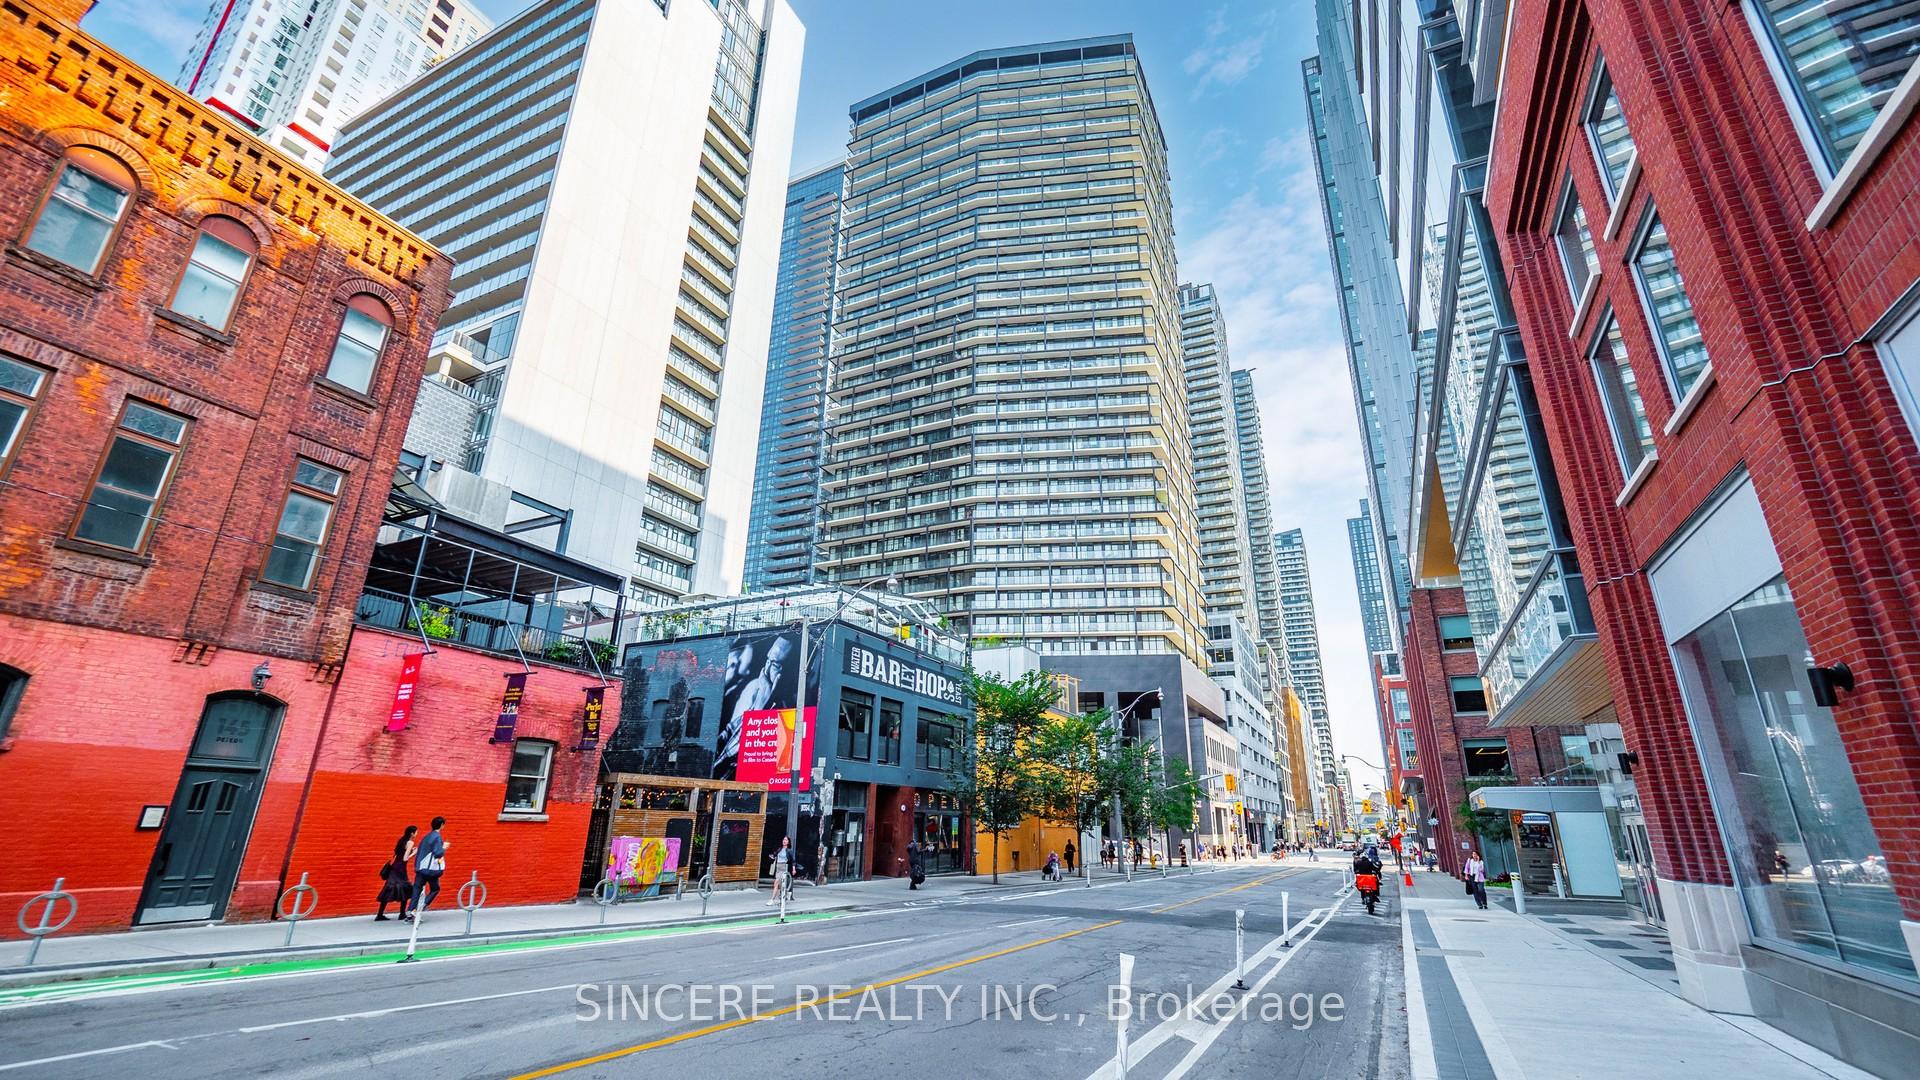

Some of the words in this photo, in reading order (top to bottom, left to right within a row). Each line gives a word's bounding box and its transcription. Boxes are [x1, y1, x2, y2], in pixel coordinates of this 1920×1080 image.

[850, 646, 861, 674] WATER
[955, 682, 963, 705] YEAST
[747, 717, 763, 727] Any
[746, 728, 760, 737] and
[753, 739, 766, 747] the
[913, 792, 960, 810] OPEN
